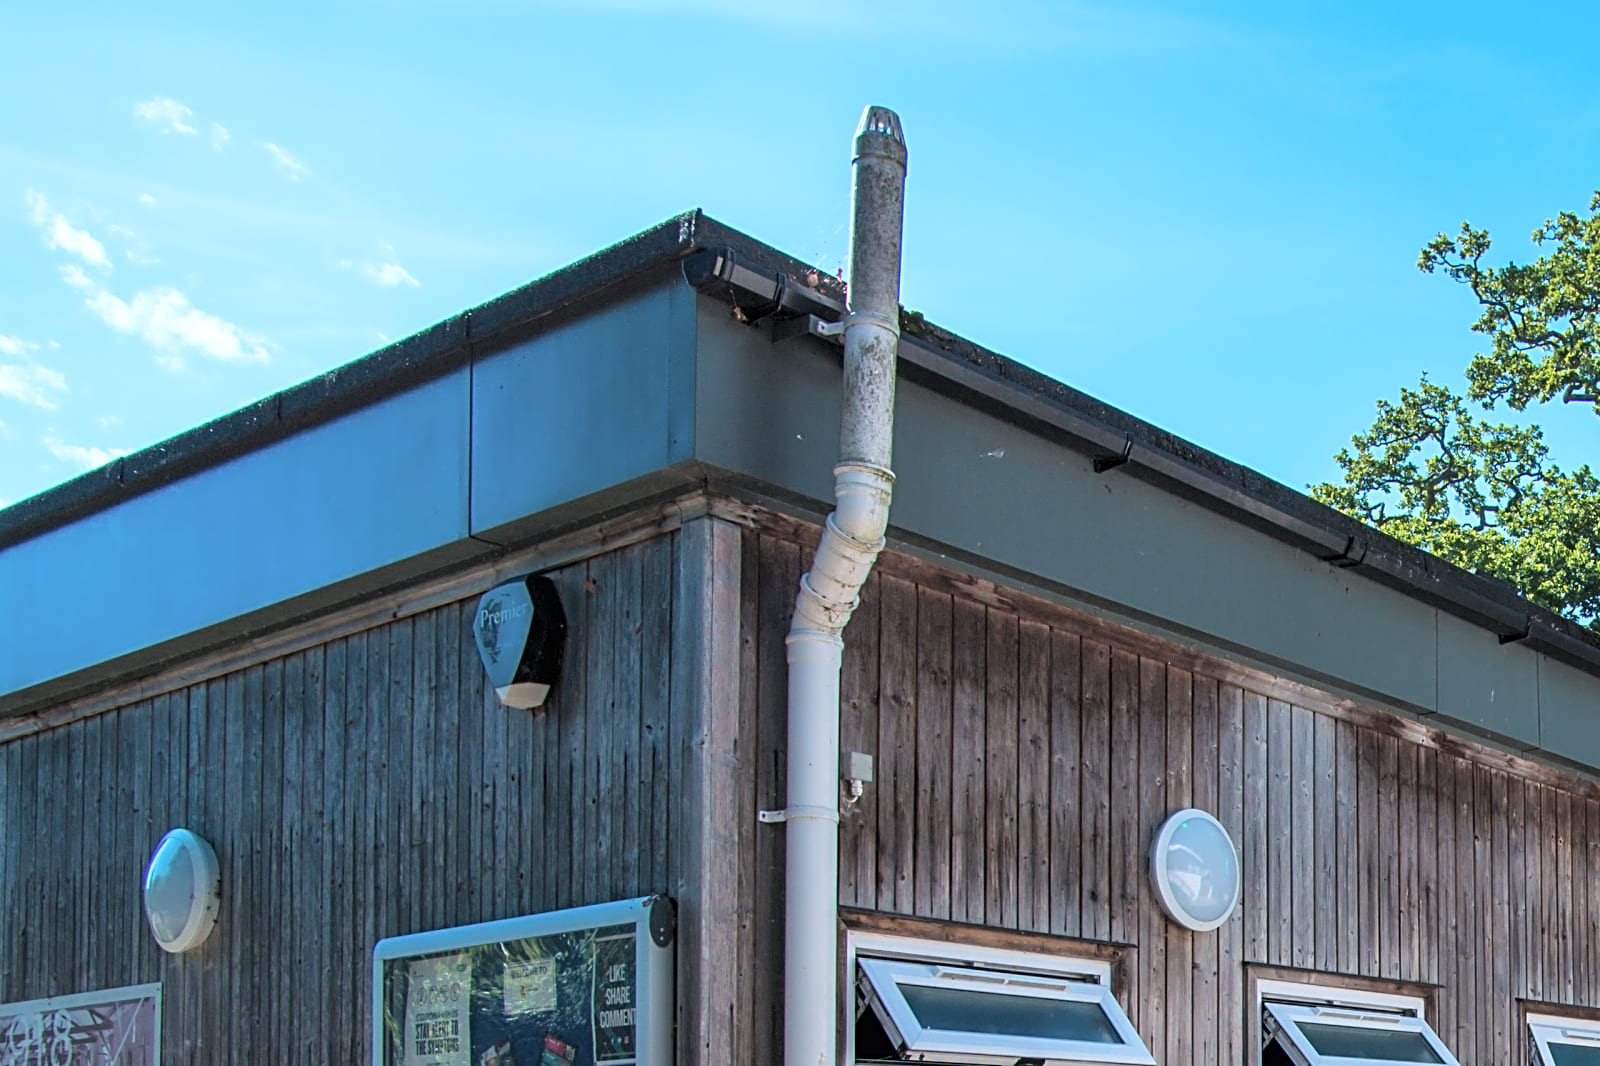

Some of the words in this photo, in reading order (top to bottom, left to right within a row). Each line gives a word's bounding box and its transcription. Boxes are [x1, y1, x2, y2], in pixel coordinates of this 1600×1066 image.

[480, 601, 528, 628] Premier
[609, 964, 626, 982] LIKE
[606, 986, 630, 1005] SHARE
